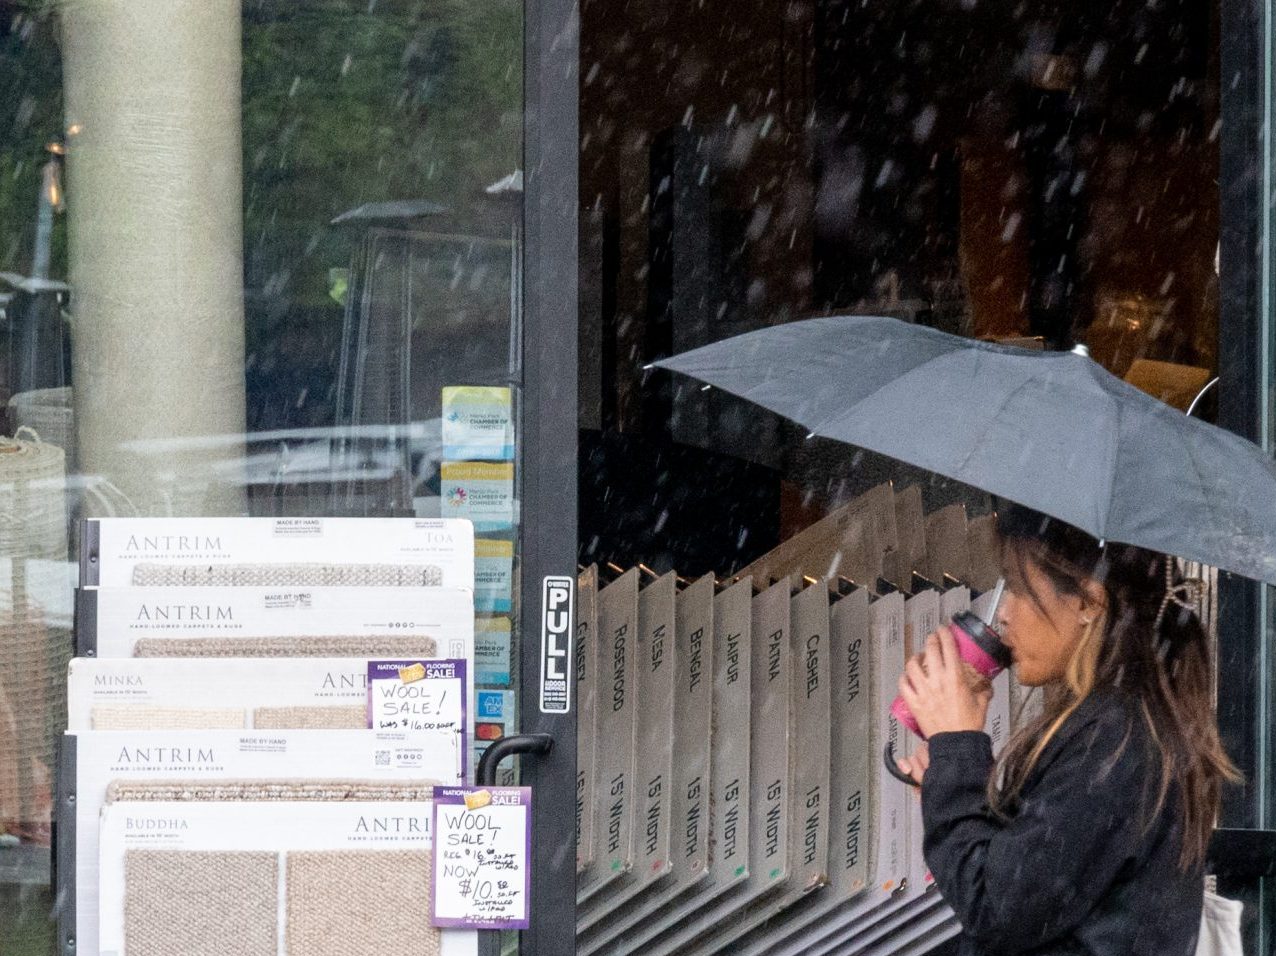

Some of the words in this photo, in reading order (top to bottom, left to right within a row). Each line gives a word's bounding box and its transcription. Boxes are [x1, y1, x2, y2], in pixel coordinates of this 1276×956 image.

[126, 535, 222, 551] ANTRIM
[426, 533, 454, 543] TOA
[137, 604, 233, 620] ANTRIM
[547, 588, 568, 679] PULL
[613, 624, 628, 712] ROSEWOOD
[651, 624, 666, 673] MESA
[689, 626, 704, 693] BENGAL
[726, 633, 741, 686] JAIPUR
[768, 628, 783, 682] PATNA
[806, 634, 820, 699] CASHEL
[847, 638, 862, 703] SONATA
[93, 675, 143, 686] MINKA
[322, 672, 368, 689] ANT
[381, 684, 431, 699] WOOL
[427, 669, 455, 679] SALE!
[117, 746, 214, 762] ANTRIM
[991, 714, 1001, 745] TAMIL
[125, 817, 189, 829] BUDDHA
[354, 815, 429, 832] ANTRI
[444, 810, 501, 830] WOOL
[492, 796, 521, 805] SALE!
[608, 797, 623, 853] WIDTH
[646, 800, 661, 856] WIDTH
[686, 802, 700, 858] WIDTH
[724, 804, 738, 860] WIDTH
[766, 803, 780, 858] WIDTH
[804, 810, 819, 865] WIDTH
[846, 814, 861, 869] WIDTH
[443, 865, 480, 878] NOW
